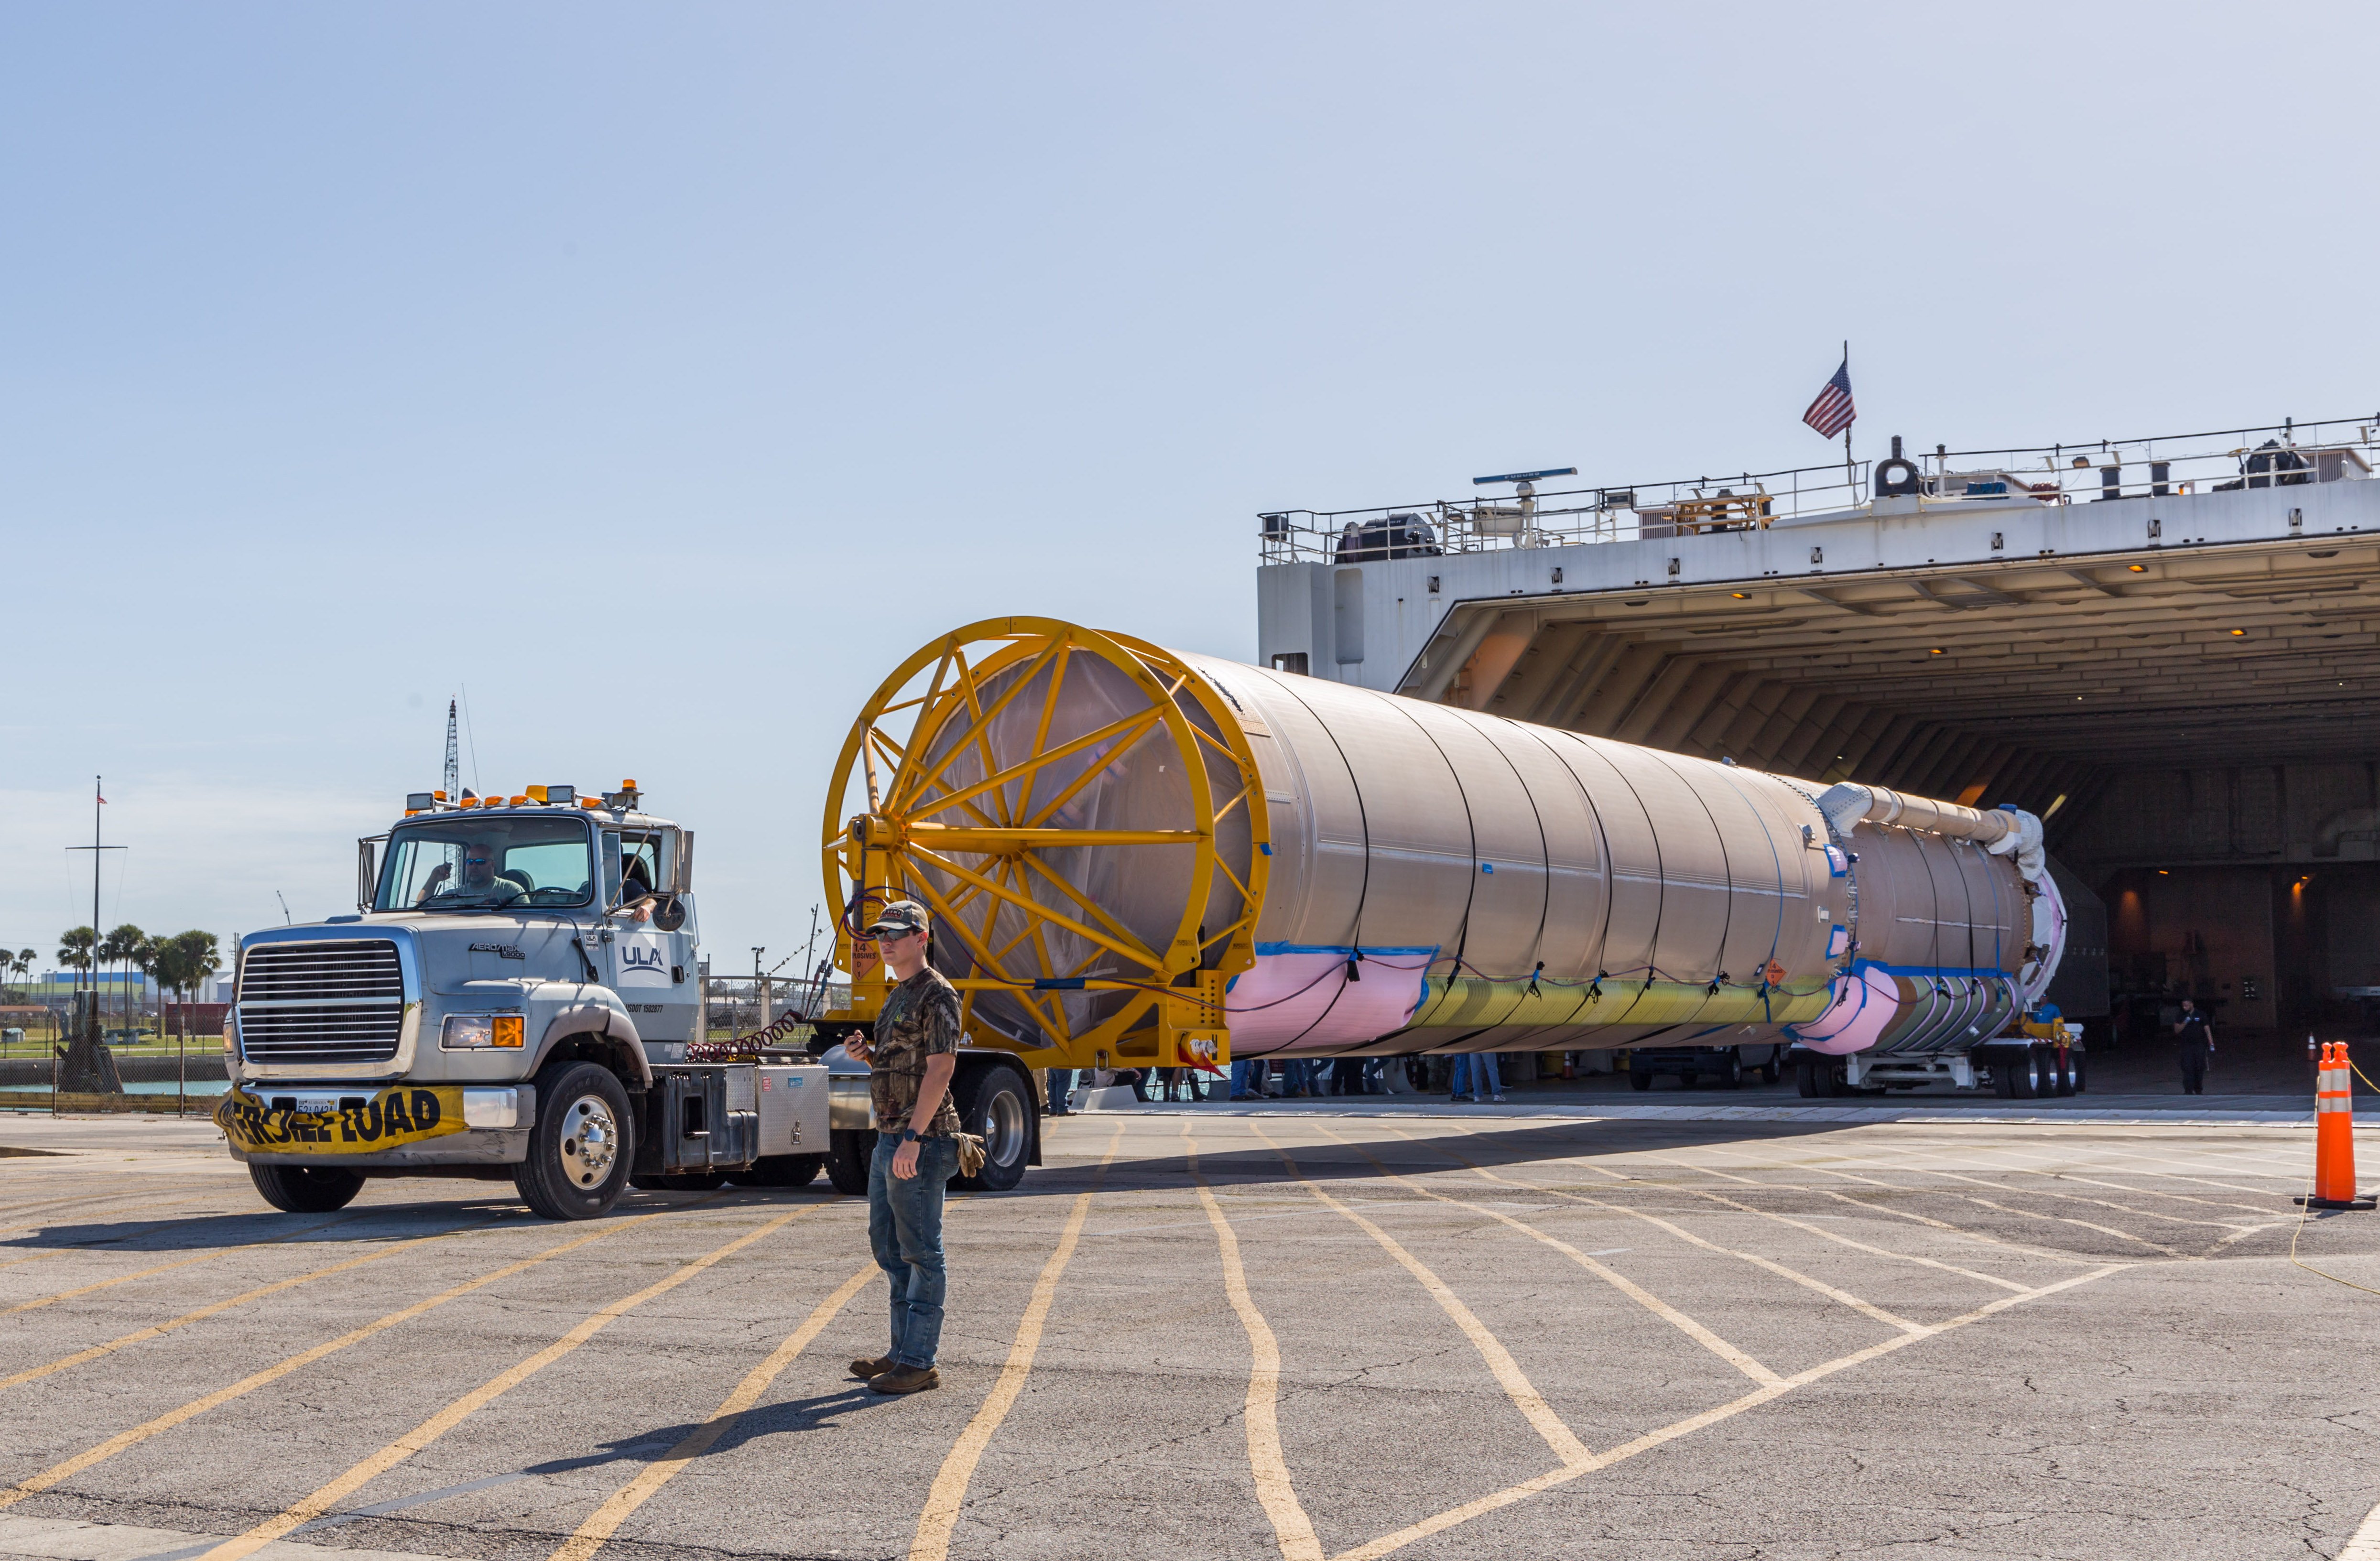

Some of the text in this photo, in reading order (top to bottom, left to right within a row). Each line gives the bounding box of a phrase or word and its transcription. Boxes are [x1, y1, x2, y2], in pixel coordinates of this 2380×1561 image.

[854, 943, 867, 952] 1.4
[622, 946, 663, 965] ULA
[643, 1005, 663, 1013] 1502877
[337, 1090, 440, 1142] LOAD
